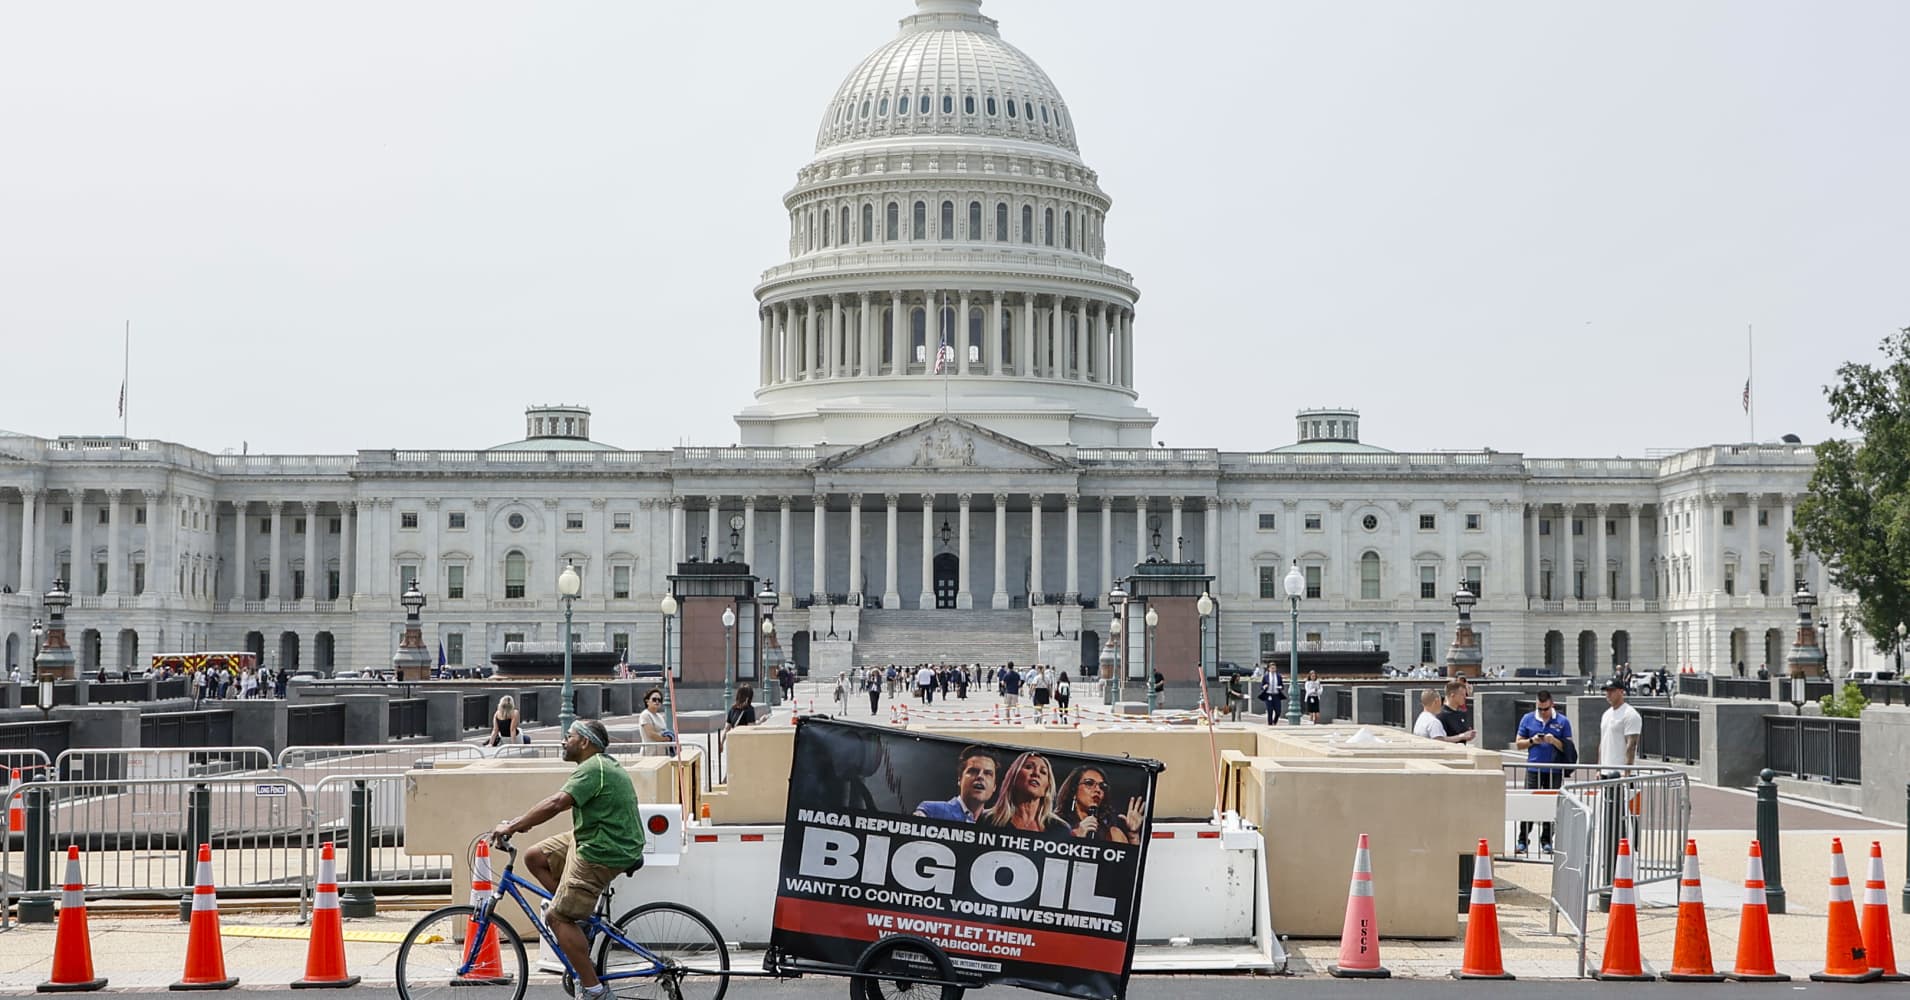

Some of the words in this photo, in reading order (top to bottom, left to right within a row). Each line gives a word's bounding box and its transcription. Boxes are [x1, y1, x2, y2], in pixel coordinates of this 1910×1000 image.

[798, 809, 851, 828] MAGA
[855, 816, 976, 844] REPUBLICANS
[978, 832, 996, 847] IN
[1000, 835, 1031, 850] THE
[1033, 839, 1100, 859] POCKET
[1103, 849, 1126, 863] OF
[799, 826, 957, 894] BIG
[970, 851, 1116, 916] OIL
[785, 878, 836, 896] WANT
[840, 885, 862, 899] TO
[865, 889, 945, 910] CONTROL
[950, 899, 998, 918] YOUR
[1000, 906, 1123, 933] INVESTMENTS
[866, 913, 893, 928] WE
[897, 917, 952, 936] WON'T
[955, 925, 983, 940] LET
[986, 929, 1036, 946] THEM.
[1360, 919, 1368, 954] USCP
